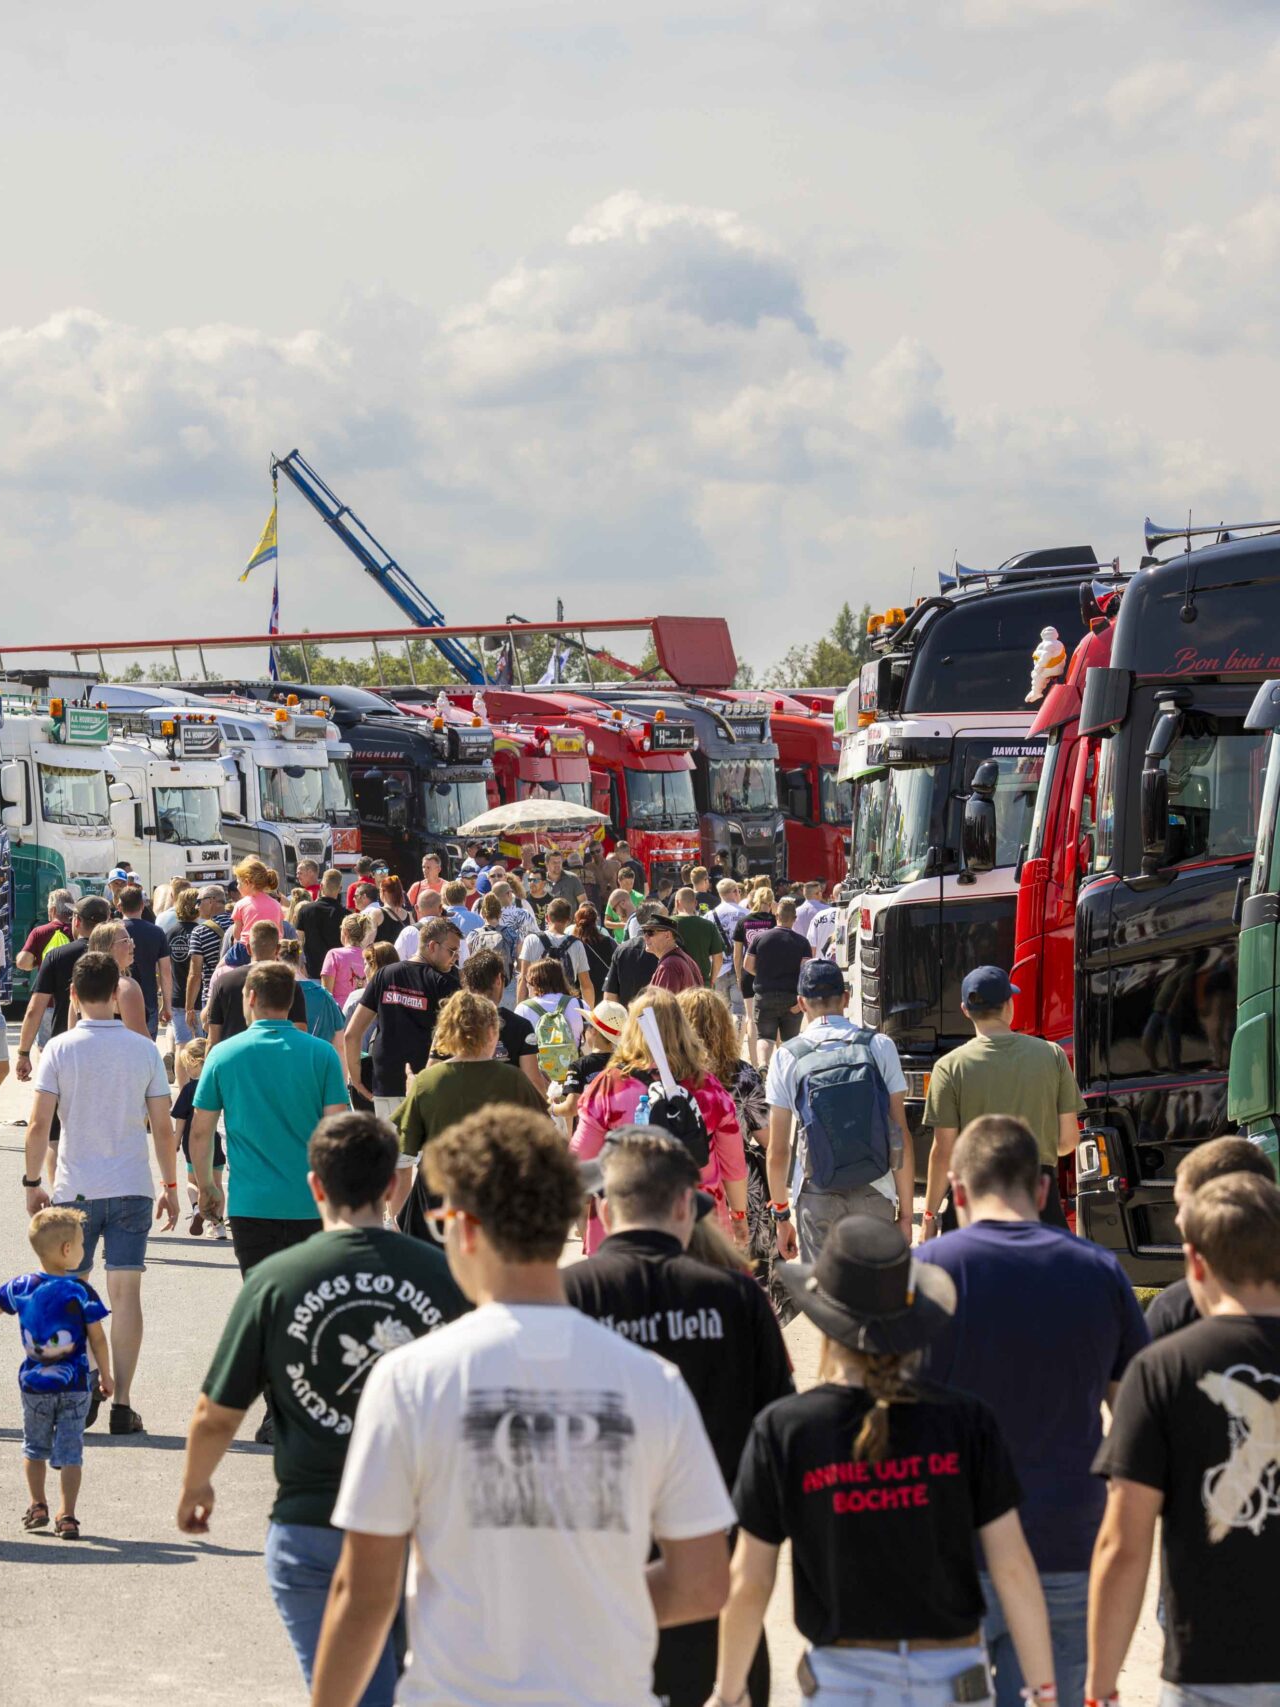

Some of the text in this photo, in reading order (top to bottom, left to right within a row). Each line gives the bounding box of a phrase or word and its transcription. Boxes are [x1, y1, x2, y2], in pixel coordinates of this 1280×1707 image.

[1174, 648, 1220, 673] Bon
[1225, 648, 1265, 670] bini
[992, 747, 1019, 756] HAWK
[201, 851, 220, 861] SCANIA
[287, 1275, 351, 1345] ASHES
[355, 1272, 395, 1294] TO
[666, 1307, 724, 1341] Veld
[286, 1362, 353, 1435] ECTIVE
[802, 1460, 871, 1494] ANNIE
[928, 1452, 960, 1475] DE
[832, 1483, 929, 1515] BOCHTE
